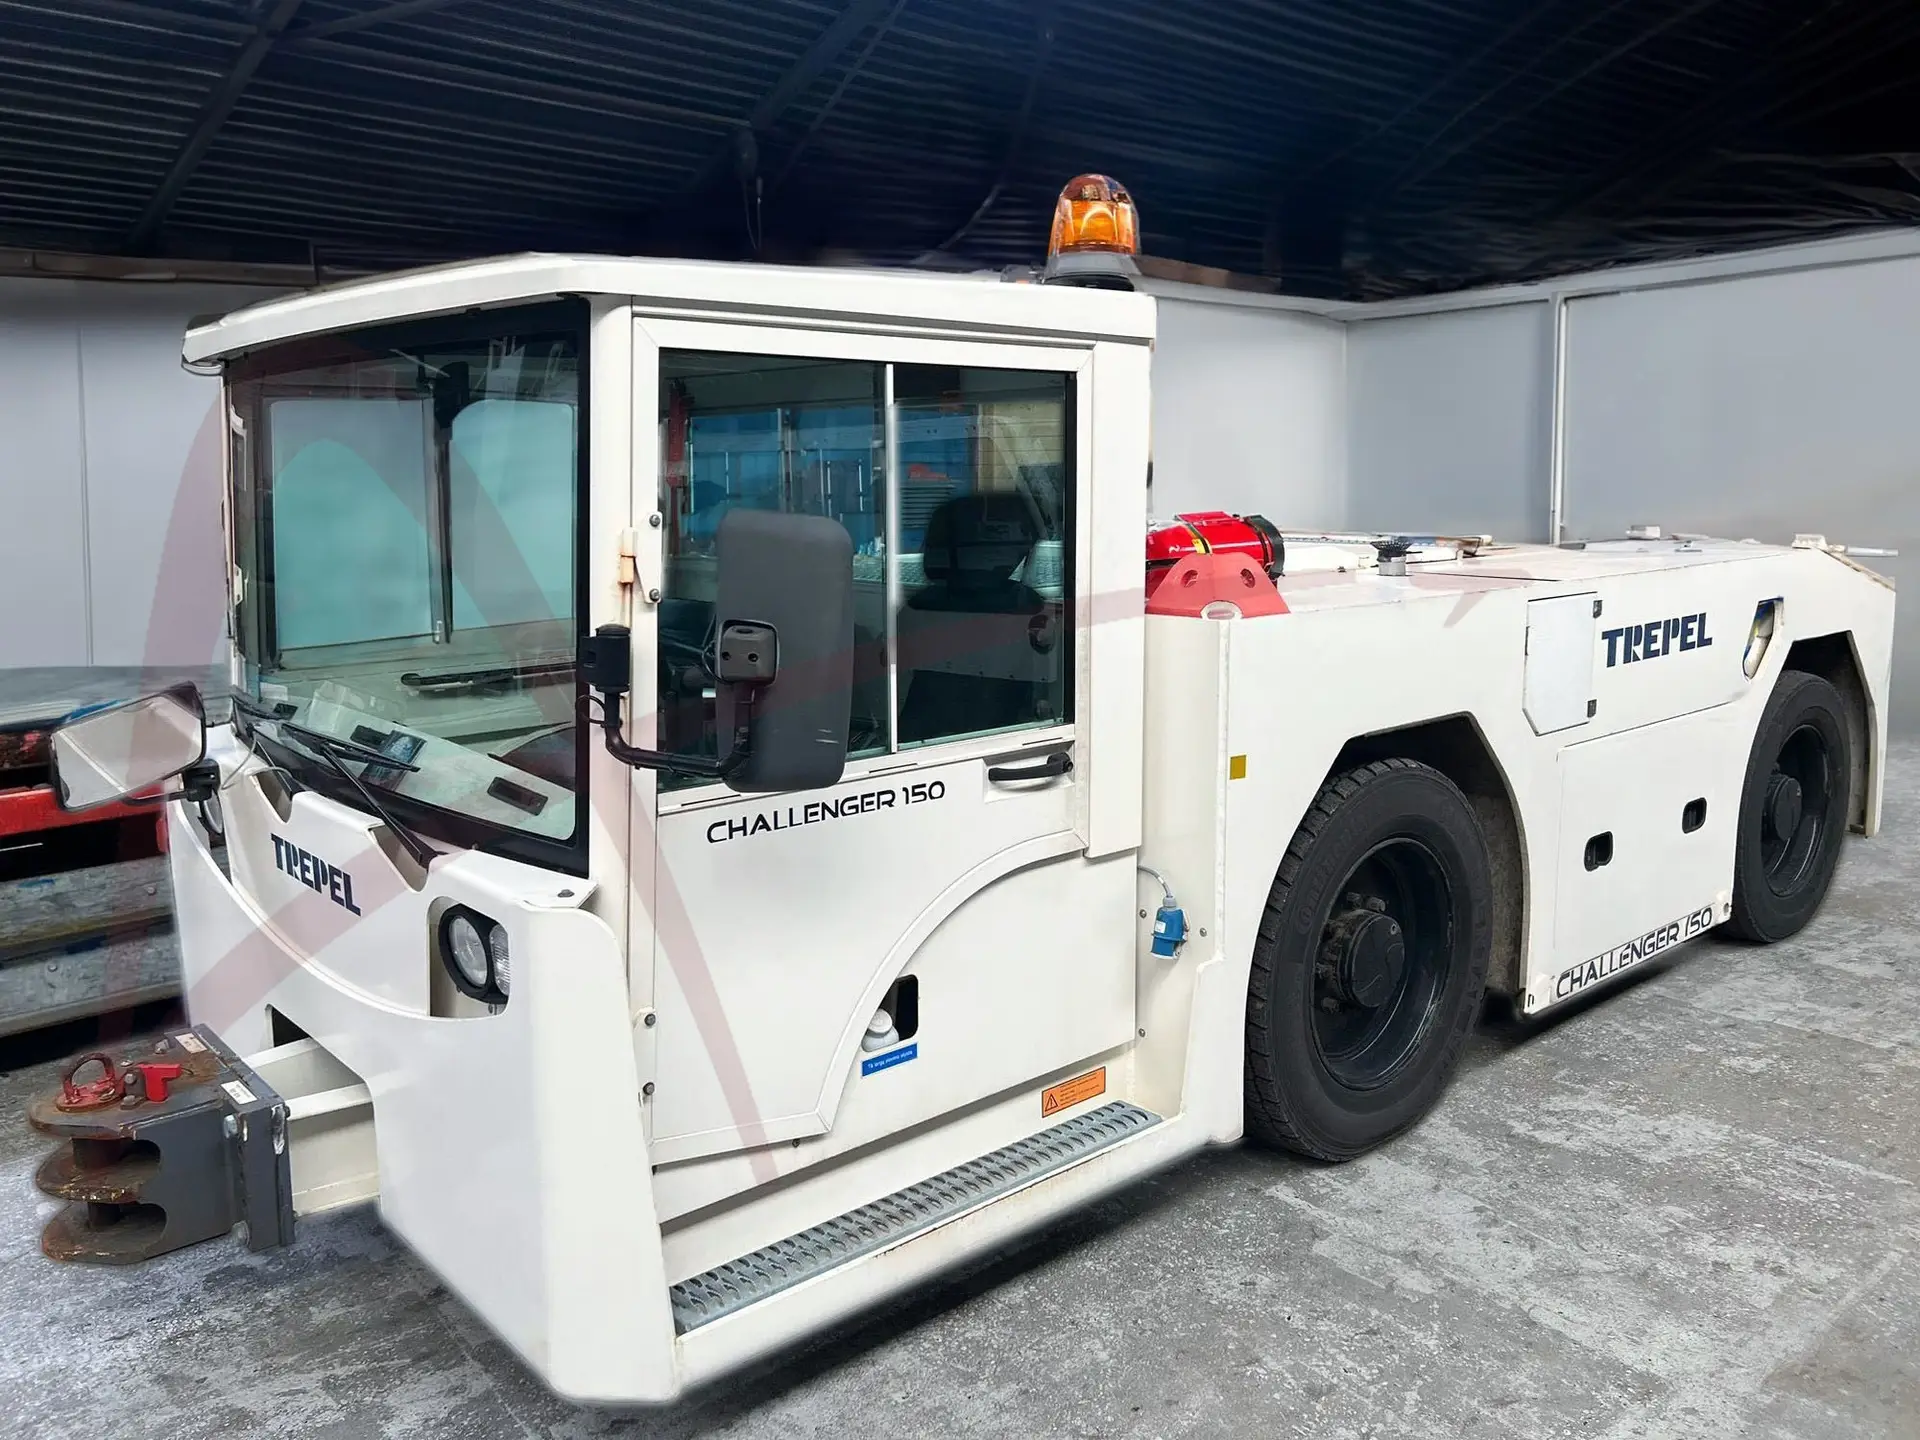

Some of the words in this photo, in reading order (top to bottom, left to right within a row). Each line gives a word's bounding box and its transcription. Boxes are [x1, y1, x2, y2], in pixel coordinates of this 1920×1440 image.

[1602, 613, 1712, 668] TREPEL
[707, 789, 896, 843] CHALLENGER
[902, 780, 945, 805] 150
[270, 832, 361, 917] TREPEL
[1556, 921, 1680, 999] CHALLENGER
[1684, 907, 1712, 937] 150
